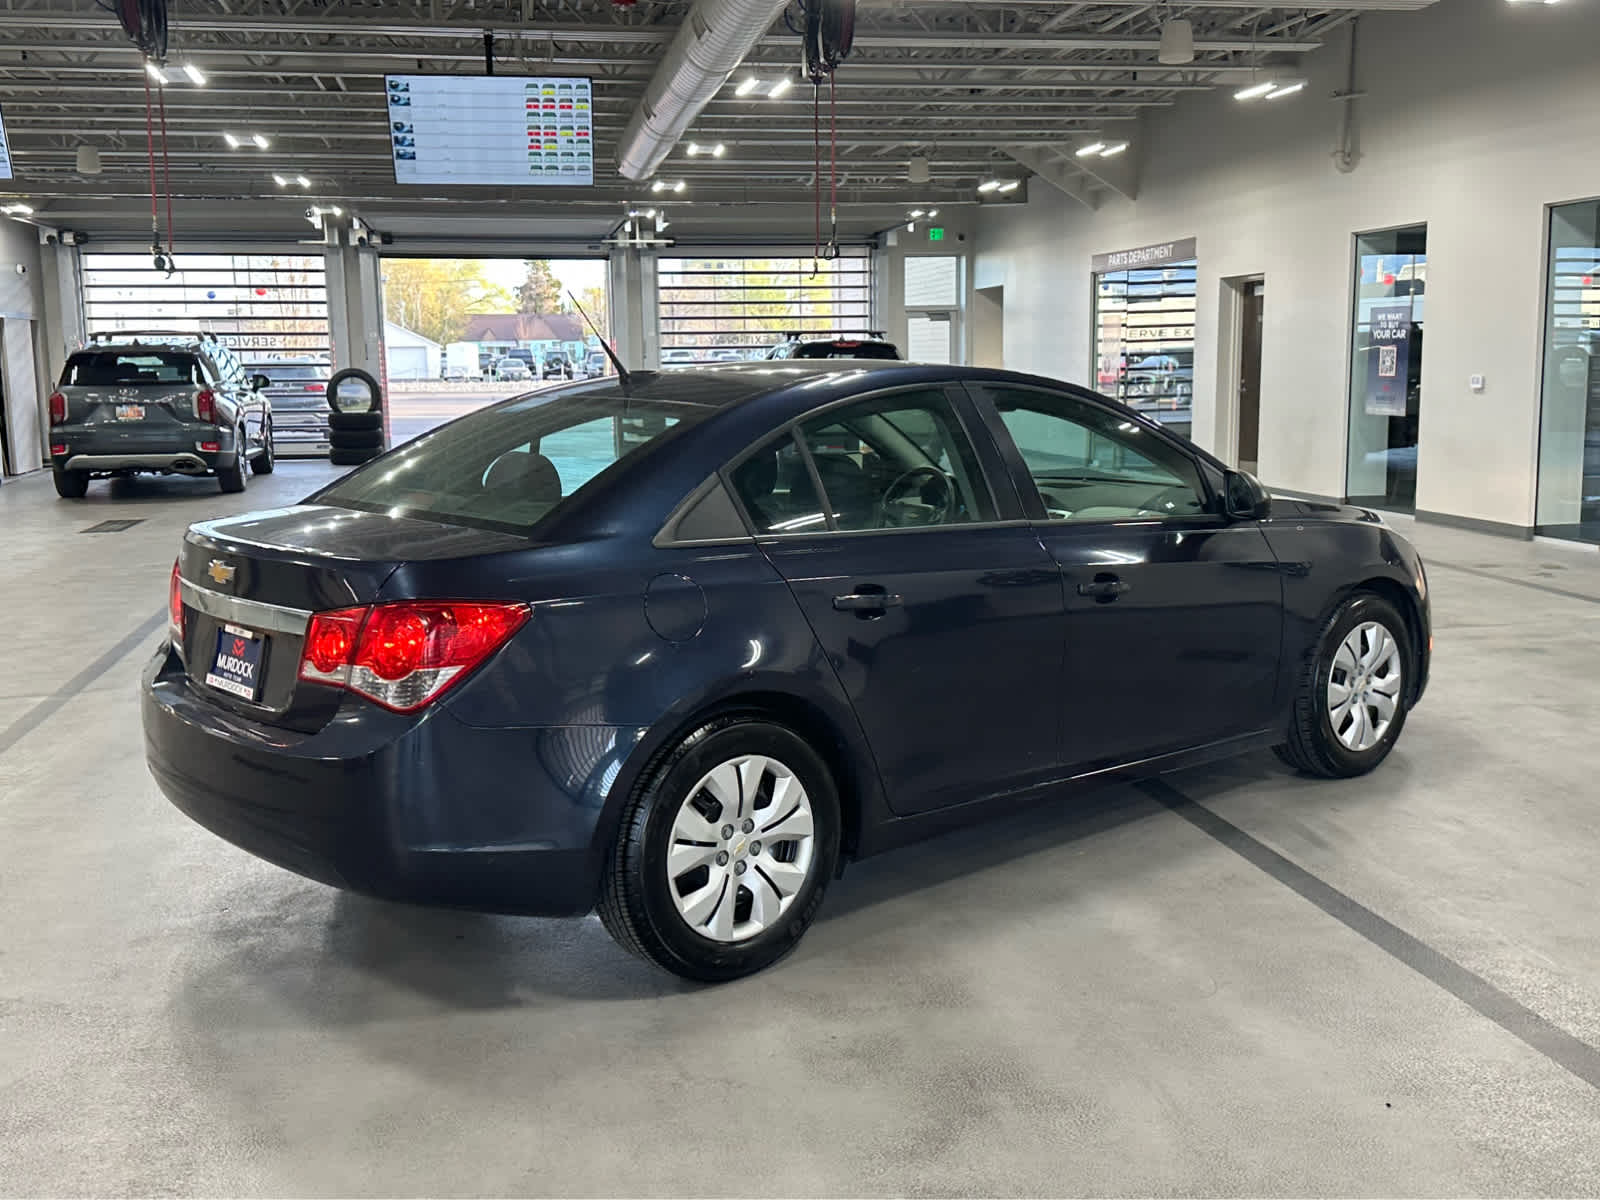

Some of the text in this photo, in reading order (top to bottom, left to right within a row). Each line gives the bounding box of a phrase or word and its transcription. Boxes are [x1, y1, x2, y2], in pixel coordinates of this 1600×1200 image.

[1108, 245, 1173, 265] PARTS DEPARTMENT
[1372, 328, 1406, 339] YOUR CAR
[217, 653, 254, 679] MURDOCK
